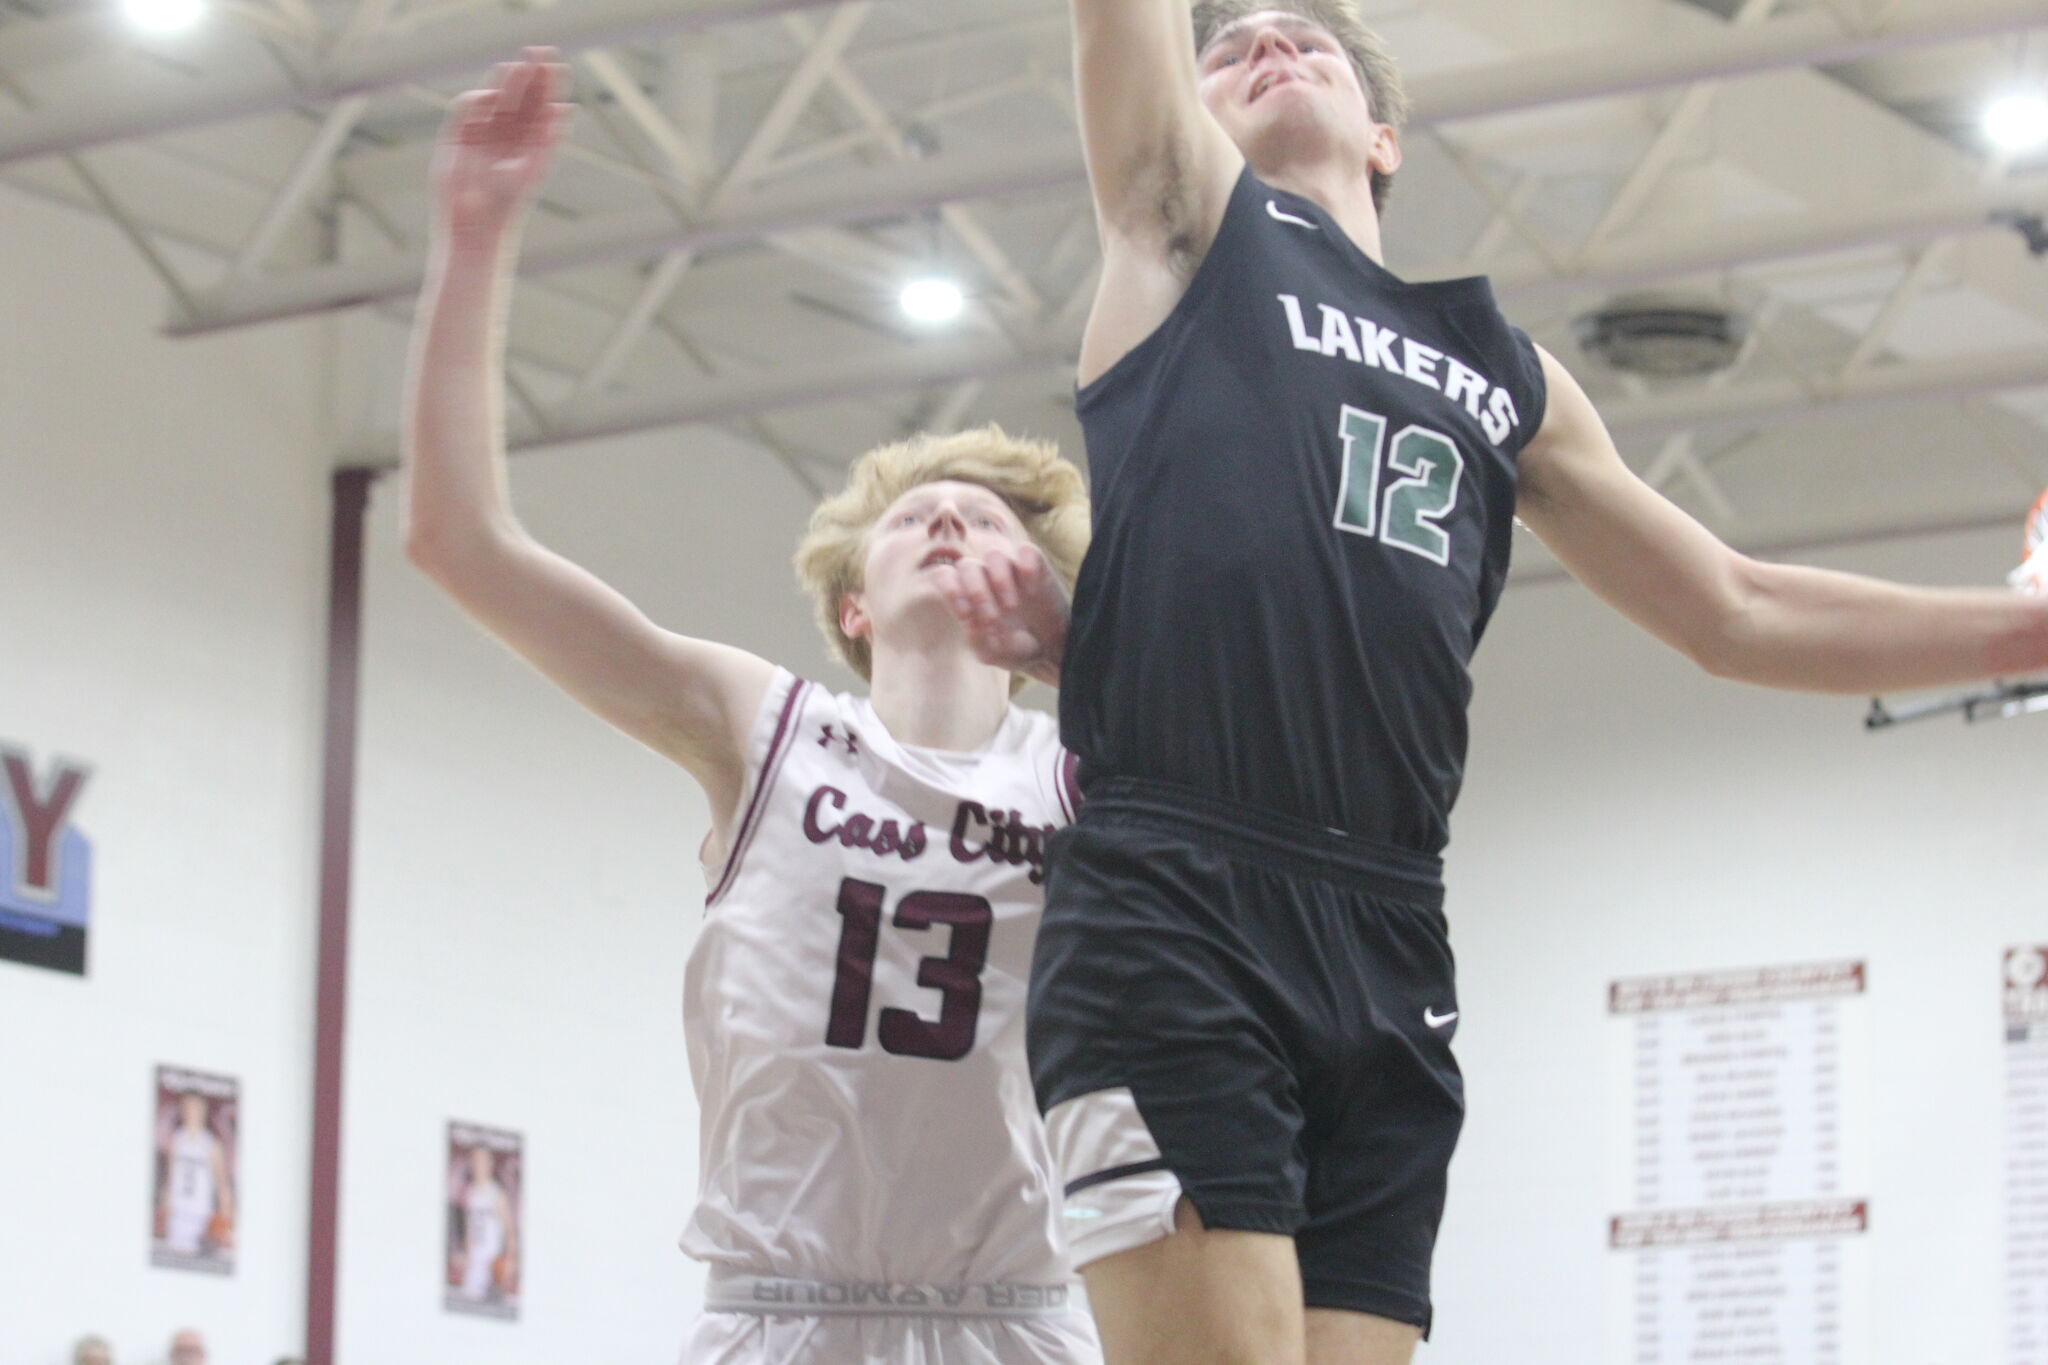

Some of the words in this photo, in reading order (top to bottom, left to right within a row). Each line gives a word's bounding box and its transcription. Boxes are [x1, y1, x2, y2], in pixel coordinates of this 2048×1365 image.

[1277, 294, 1519, 446] LAKERS
[1333, 403, 1464, 567] 12
[803, 785, 927, 862] Cass
[825, 876, 993, 1062] 13
